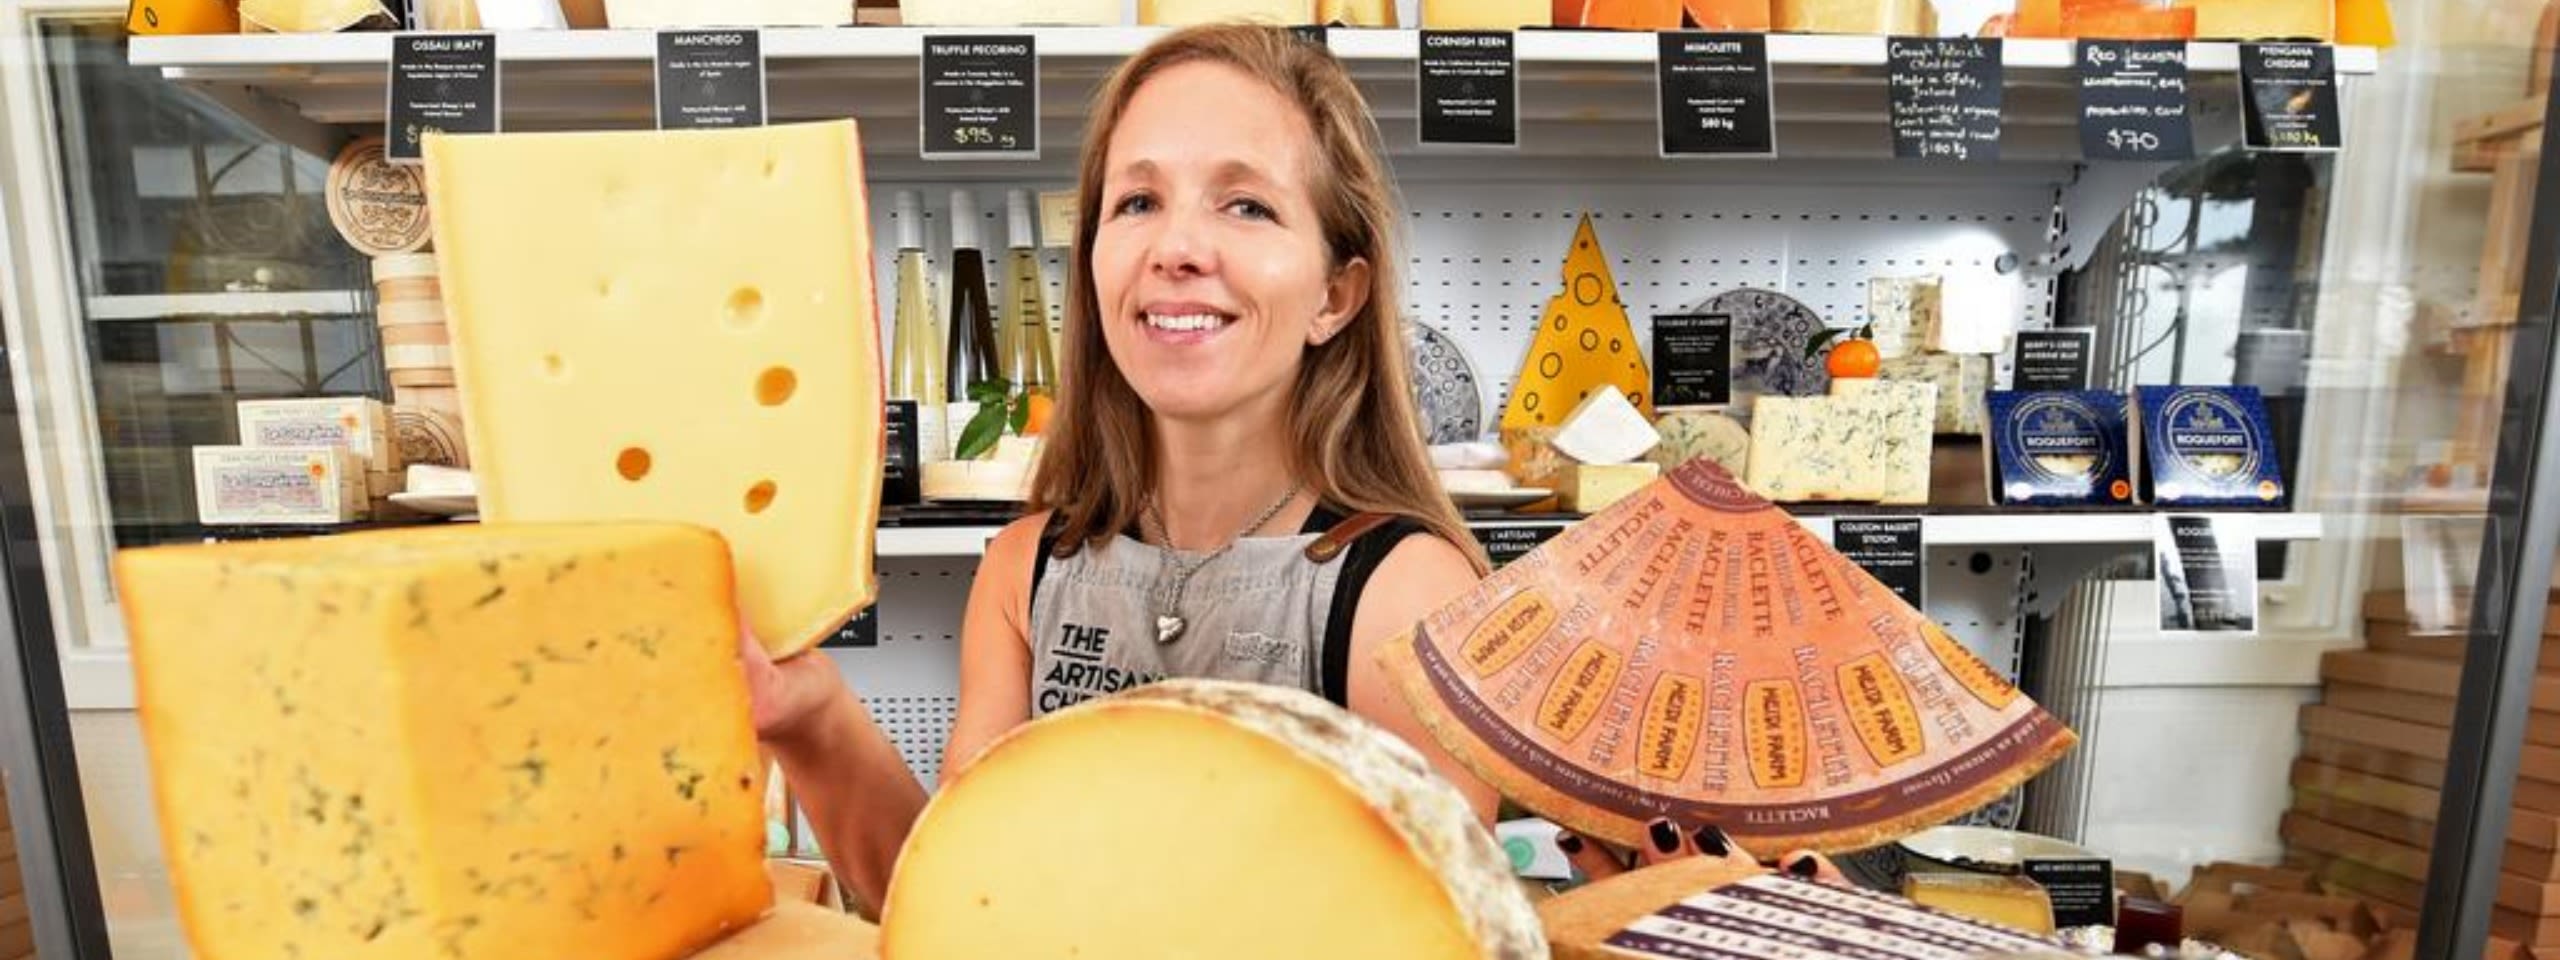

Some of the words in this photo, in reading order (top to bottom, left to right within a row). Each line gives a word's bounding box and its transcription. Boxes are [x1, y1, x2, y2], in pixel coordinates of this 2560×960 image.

[674, 34, 744, 46] MANCHEGO
[931, 44, 970, 56] TRUFFLE
[972, 44, 1028, 56] PECORINO
[954, 127, 993, 144] $95
[1722, 118, 1734, 130] kg
[2107, 128, 2159, 152] $70
[2026, 437, 2096, 447] ROQUEFORT
[2176, 434, 2244, 446] ROQUEFORT
[1576, 497, 1665, 575] RACLETTE
[1623, 517, 1694, 610] RACLETTE
[1685, 528, 1727, 637] RACLETTE
[1784, 520, 1845, 622] RACLETTE
[1746, 530, 1774, 638] RACLETTE
[1061, 624, 1110, 653] THE
[1044, 660, 1165, 694] ARTISA
[1551, 688, 1582, 730] FARM
[1702, 650, 1738, 794] RACLETTE
[1652, 726, 1678, 770] FARM
[1873, 708, 1907, 755] FARM
[1768, 735, 1787, 780] FARM
[1745, 805, 1832, 824] RACLETTE
